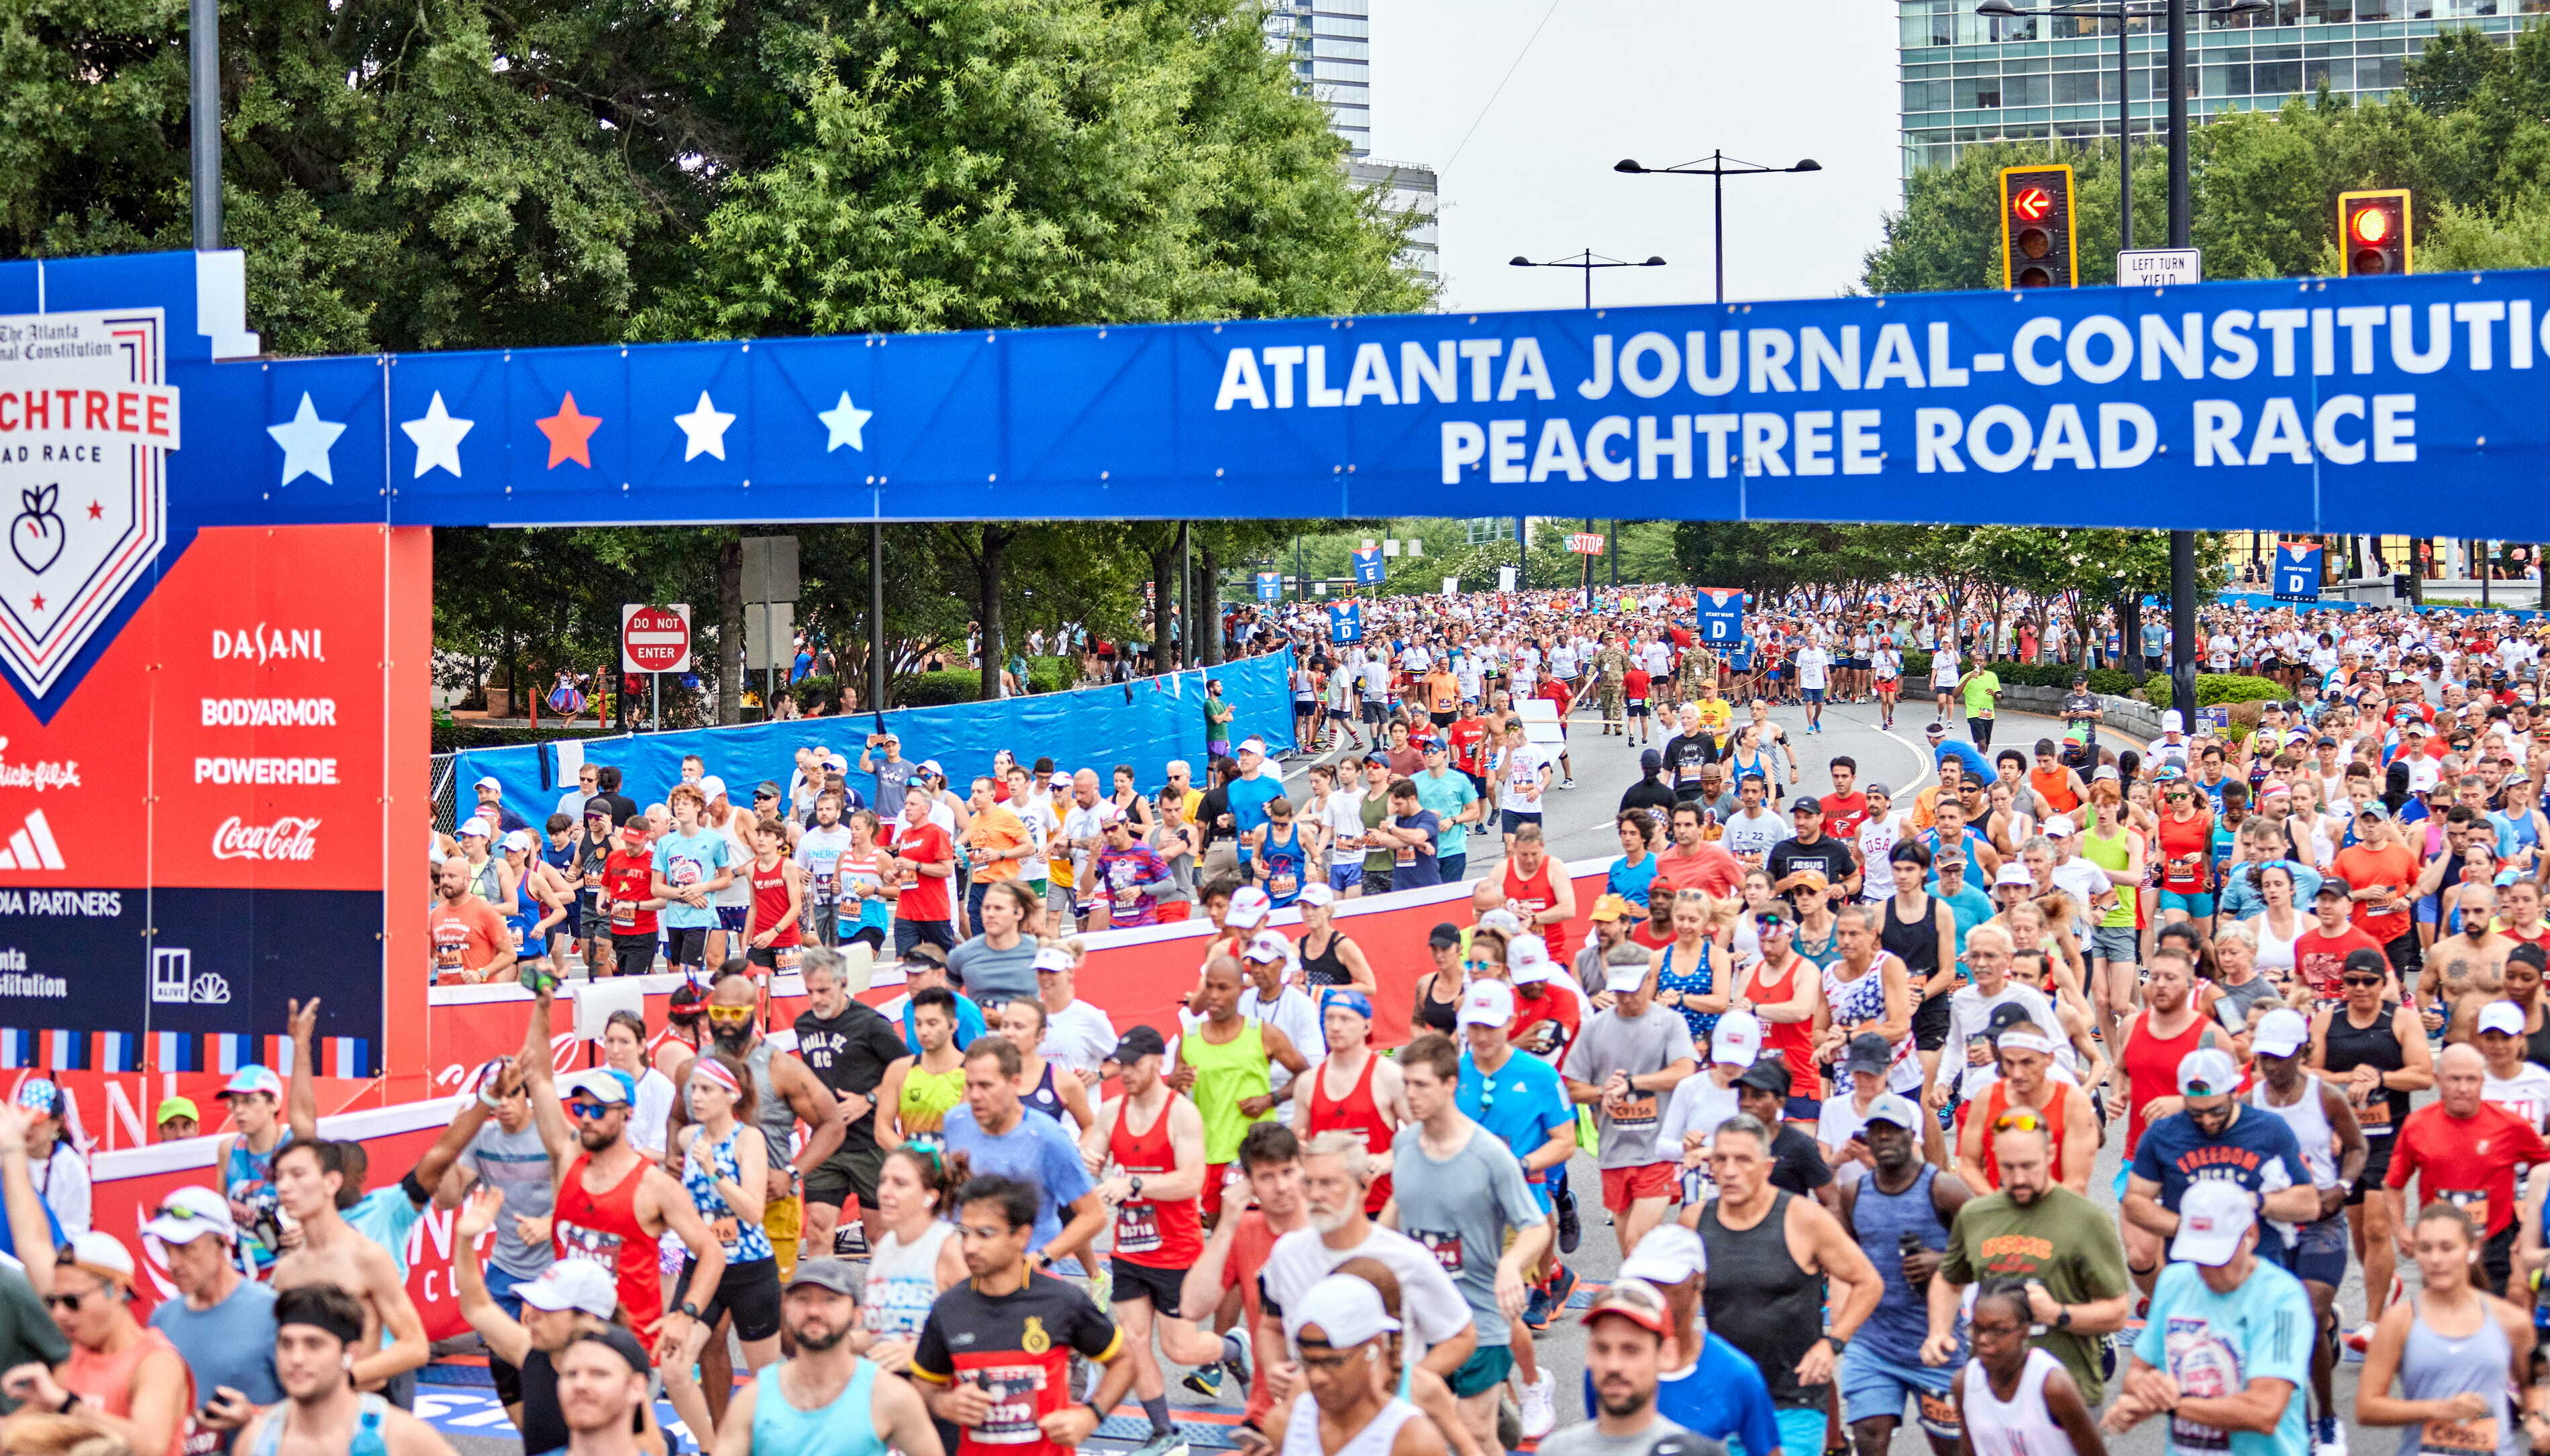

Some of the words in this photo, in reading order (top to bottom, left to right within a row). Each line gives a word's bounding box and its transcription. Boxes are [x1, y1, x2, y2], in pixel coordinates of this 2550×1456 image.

[2133, 258, 2153, 270] LEFT
[2160, 258, 2184, 270] TURN
[27, 324, 79, 341] Atlanta
[1215, 337, 1556, 411] ATLANTA
[1578, 299, 2550, 401] JOURNAL-CONSTITUTI
[1441, 409, 1882, 485] PEACHTREE
[1916, 403, 2158, 474] ROAD
[2193, 393, 2416, 466] RACE
[3, 446, 28, 464] AD
[43, 444, 101, 463] RACE
[1574, 534, 1604, 553] STOP
[1365, 568, 1376, 580] E
[2289, 574, 2304, 592] D
[1266, 588, 1273, 597] E
[634, 618, 649, 629] DO
[657, 618, 679, 629] NOT
[1341, 625, 1352, 639] D
[1712, 621, 1726, 639] D
[213, 621, 322, 666] DASANI
[638, 647, 674, 658] ENTER
[201, 698, 336, 726] BODYARMOR
[195, 758, 338, 784] POWERADE
[212, 815, 322, 861] Coca-Cola
[1866, 837, 1890, 853] USA
[1790, 861, 1824, 870] JESUS
[30, 891, 121, 917] PARTNERS
[158, 989, 185, 998] ALIVE
[801, 1031, 827, 1055] MILL
[813, 1050, 832, 1068] RC
[2176, 1146, 2260, 1174] FREEDOM
